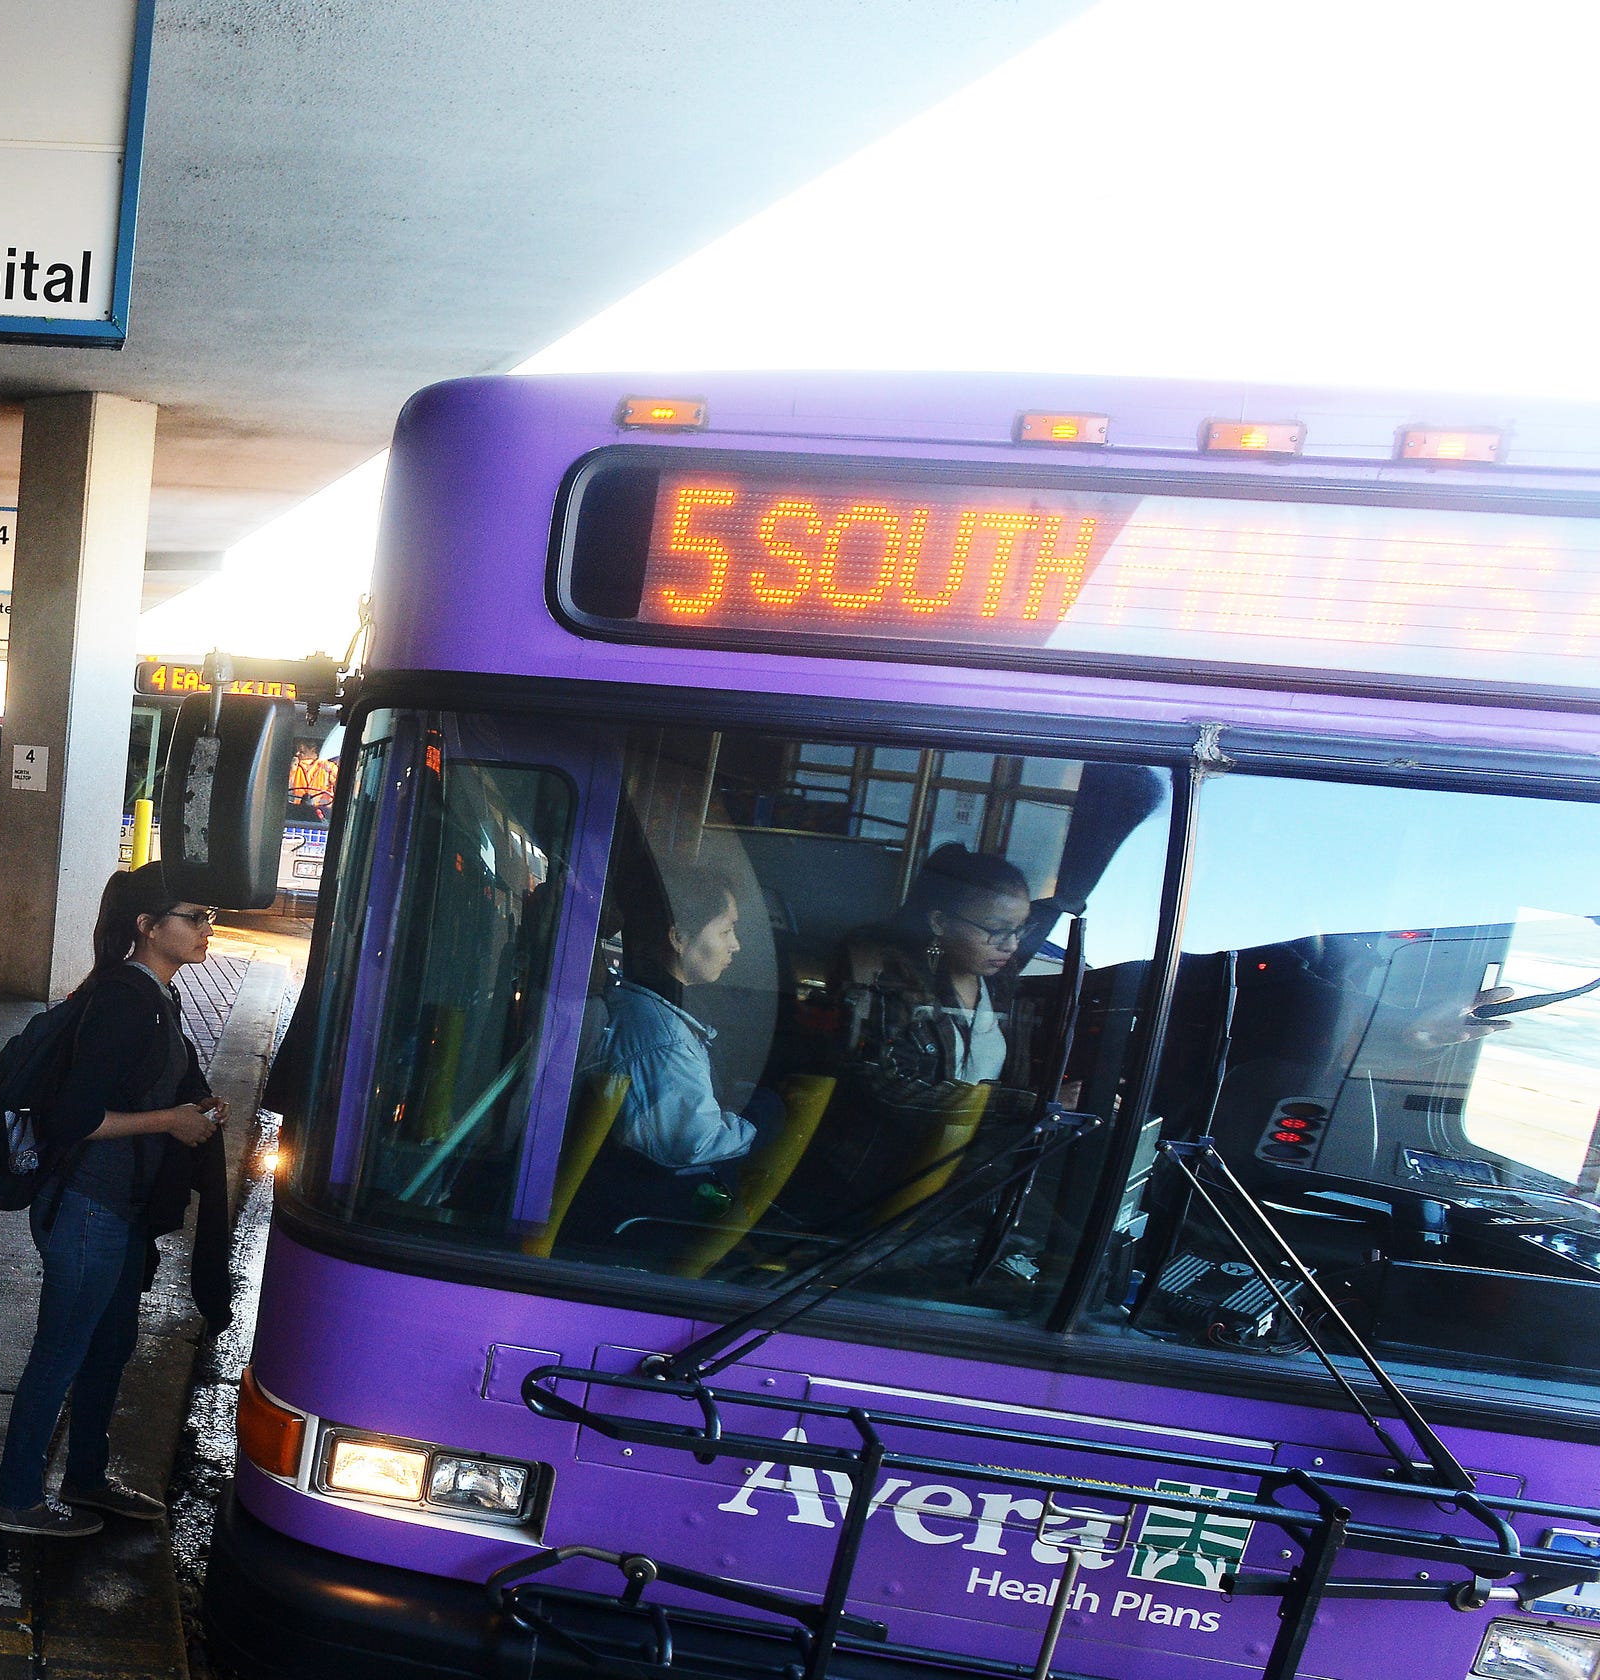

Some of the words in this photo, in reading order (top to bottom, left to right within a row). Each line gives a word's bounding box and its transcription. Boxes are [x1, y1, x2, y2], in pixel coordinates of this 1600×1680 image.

[660, 487, 735, 614] 5
[748, 500, 1098, 622] SOUTH
[151, 664, 168, 691] 4
[25, 749, 36, 764] 4
[717, 1427, 1115, 1569] Avera
[1111, 1590, 1222, 1633] Plans
